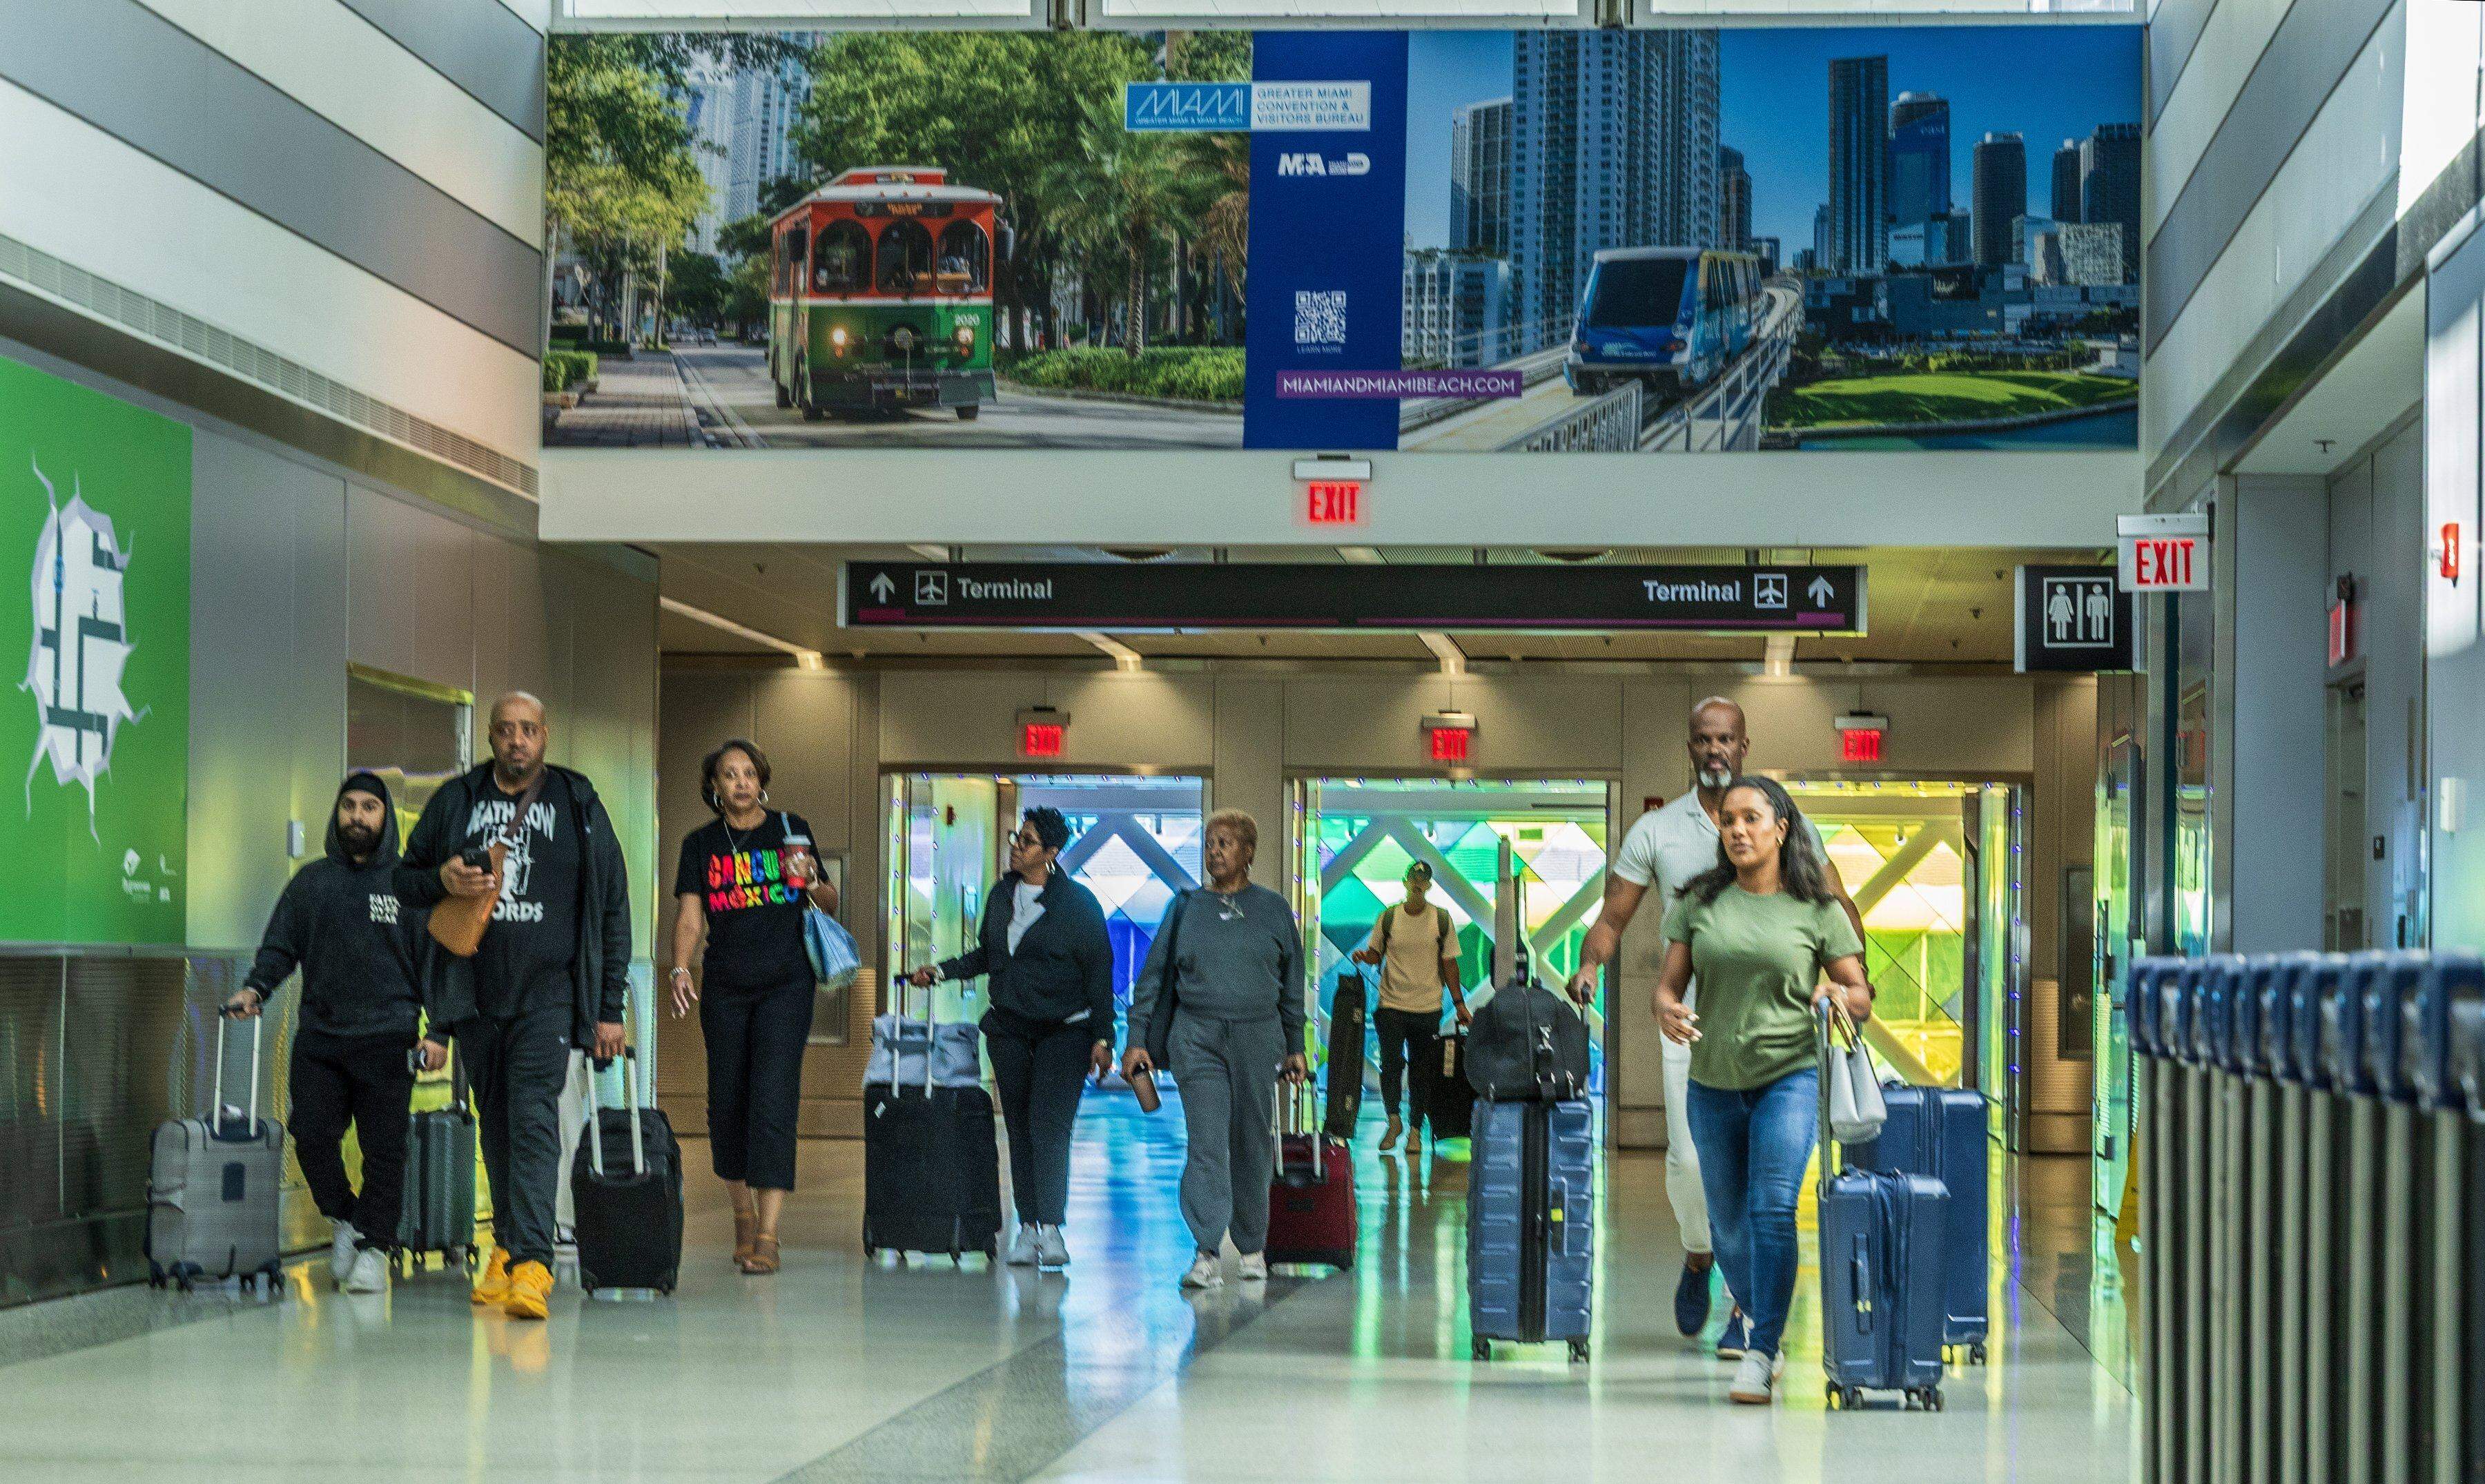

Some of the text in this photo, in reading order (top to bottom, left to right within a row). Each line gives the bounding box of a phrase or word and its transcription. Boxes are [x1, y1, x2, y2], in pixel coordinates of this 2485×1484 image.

[1137, 88, 1243, 117] MIAMI
[1257, 88, 1352, 99] GREATER MIAMI
[1257, 101, 1349, 112] CONVENTION &
[1257, 113, 1364, 124] VISITORS BUREAU
[1283, 376, 1515, 394] MIAMIANDMIAMIBEACH.COM
[1309, 481, 1361, 523] EXIT
[2134, 538, 2195, 585] EXIT
[957, 577, 1053, 599] Terminal
[1643, 580, 1741, 602] Terminal
[1026, 725, 1062, 756] EXIT
[1432, 729, 1469, 760] EXIT
[1844, 730, 1880, 761] EXIT
